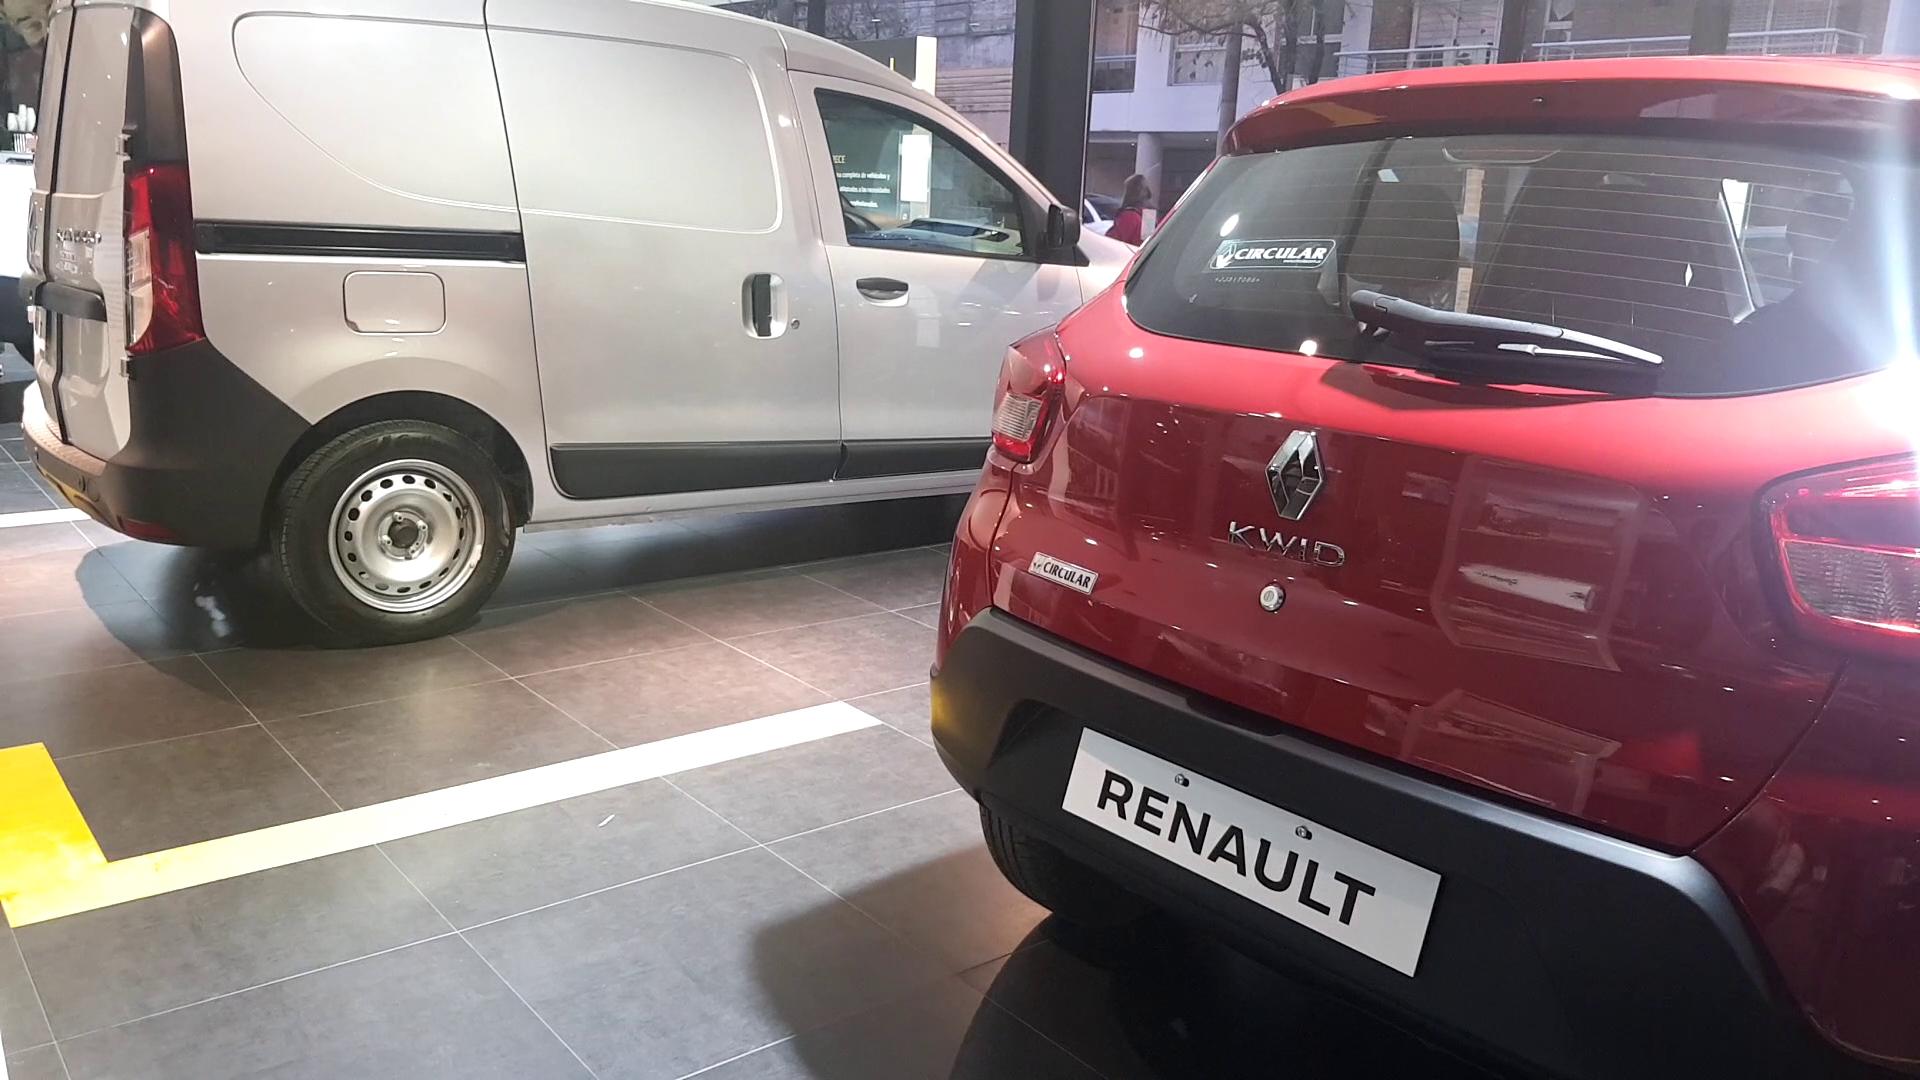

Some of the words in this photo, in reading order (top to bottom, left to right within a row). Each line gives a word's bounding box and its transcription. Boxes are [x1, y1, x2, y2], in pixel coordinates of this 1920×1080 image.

[1234, 247, 1328, 260] CIRCULAR
[1228, 521, 1345, 567] KWID
[1043, 561, 1091, 588] CIRCULAR
[1097, 769, 1376, 926] RENAULT
